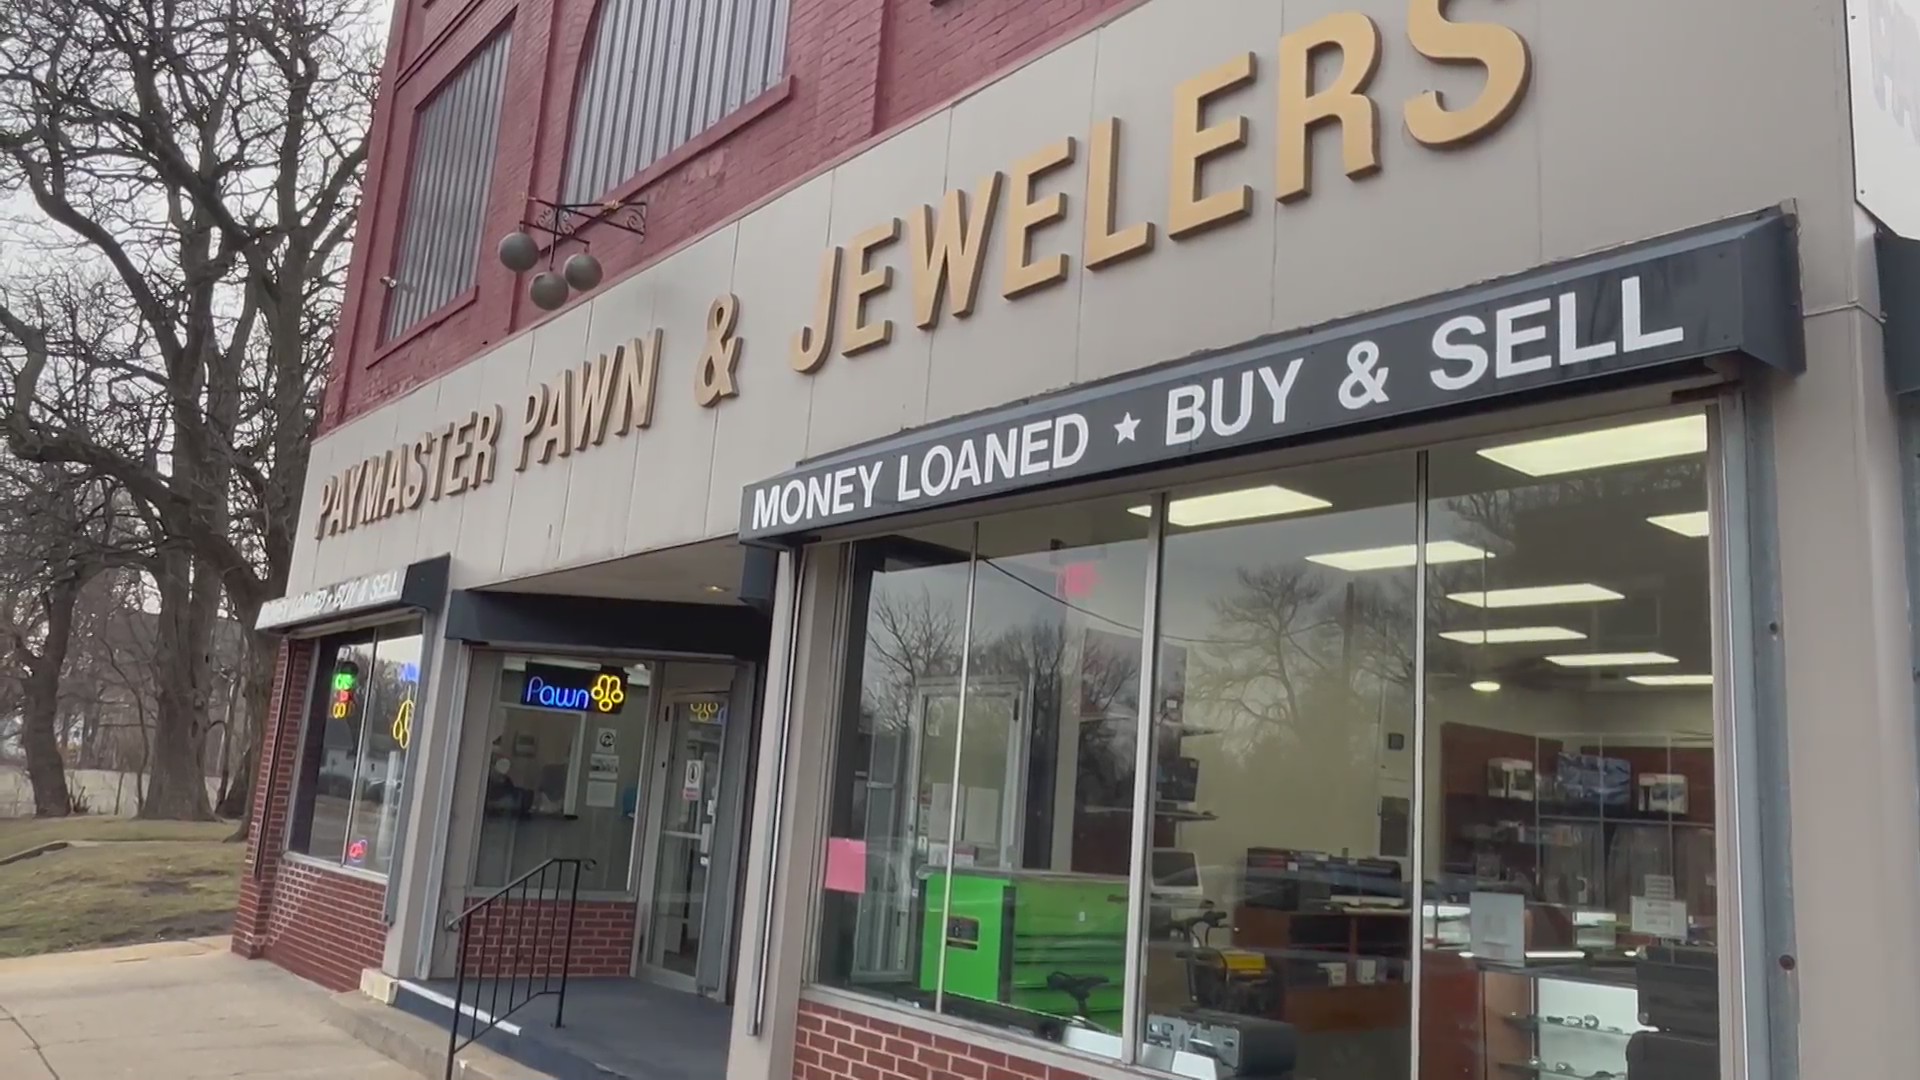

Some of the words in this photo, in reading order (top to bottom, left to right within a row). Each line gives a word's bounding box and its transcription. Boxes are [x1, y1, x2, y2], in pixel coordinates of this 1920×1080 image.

[314, 404, 503, 539] PAYMASTER
[514, 327, 665, 472] PAWN
[694, 292, 744, 408] &
[790, 0, 1533, 375] JEWELERS
[751, 461, 883, 530] MONEY
[897, 413, 1090, 502] LOANED
[1165, 358, 1304, 446] BUY
[1338, 340, 1390, 410] &
[1429, 276, 1684, 391] SELL
[526, 675, 590, 709] Pawn
